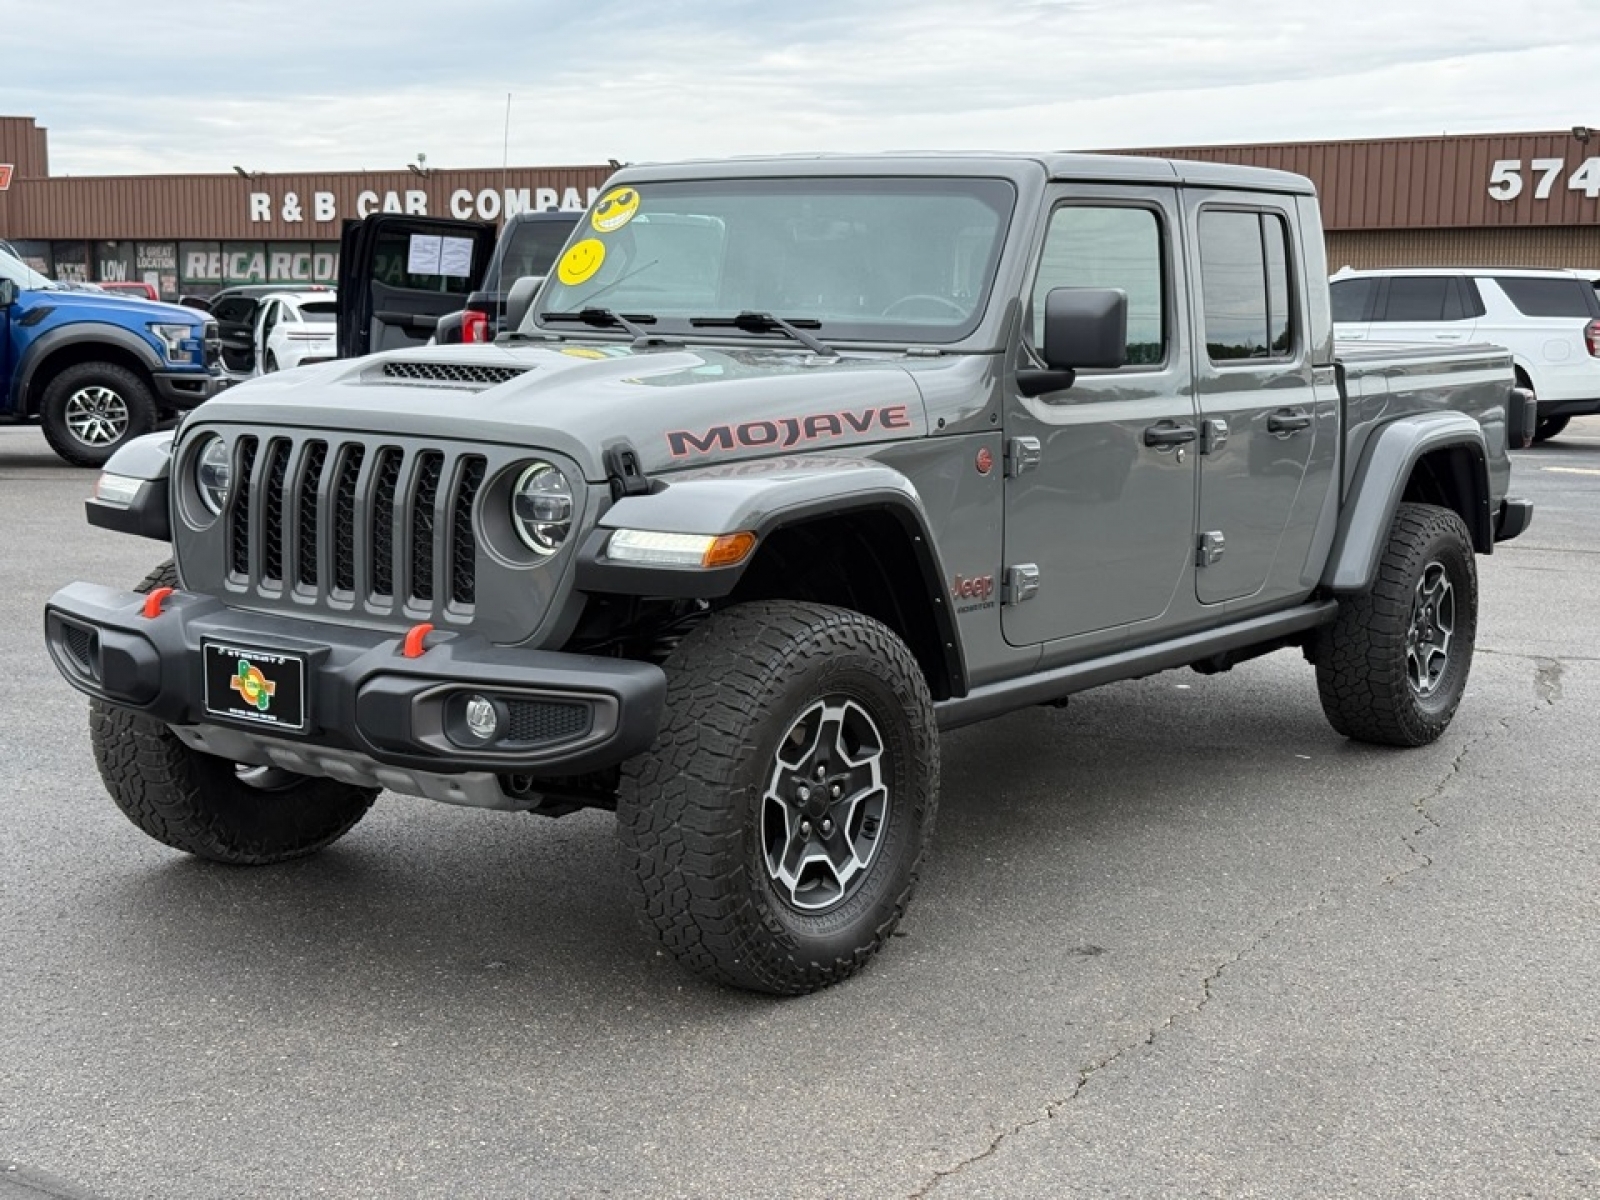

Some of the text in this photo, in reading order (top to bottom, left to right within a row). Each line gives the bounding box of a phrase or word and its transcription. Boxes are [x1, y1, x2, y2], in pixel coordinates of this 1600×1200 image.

[1487, 157, 1600, 201] 574
[250, 192, 271, 222] R
[281, 192, 303, 222] &
[314, 191, 336, 221] B
[357, 189, 428, 221] CAR
[101, 260, 127, 282] LOW
[667, 405, 911, 458] MOJAVE
[951, 573, 994, 601] Jeep
